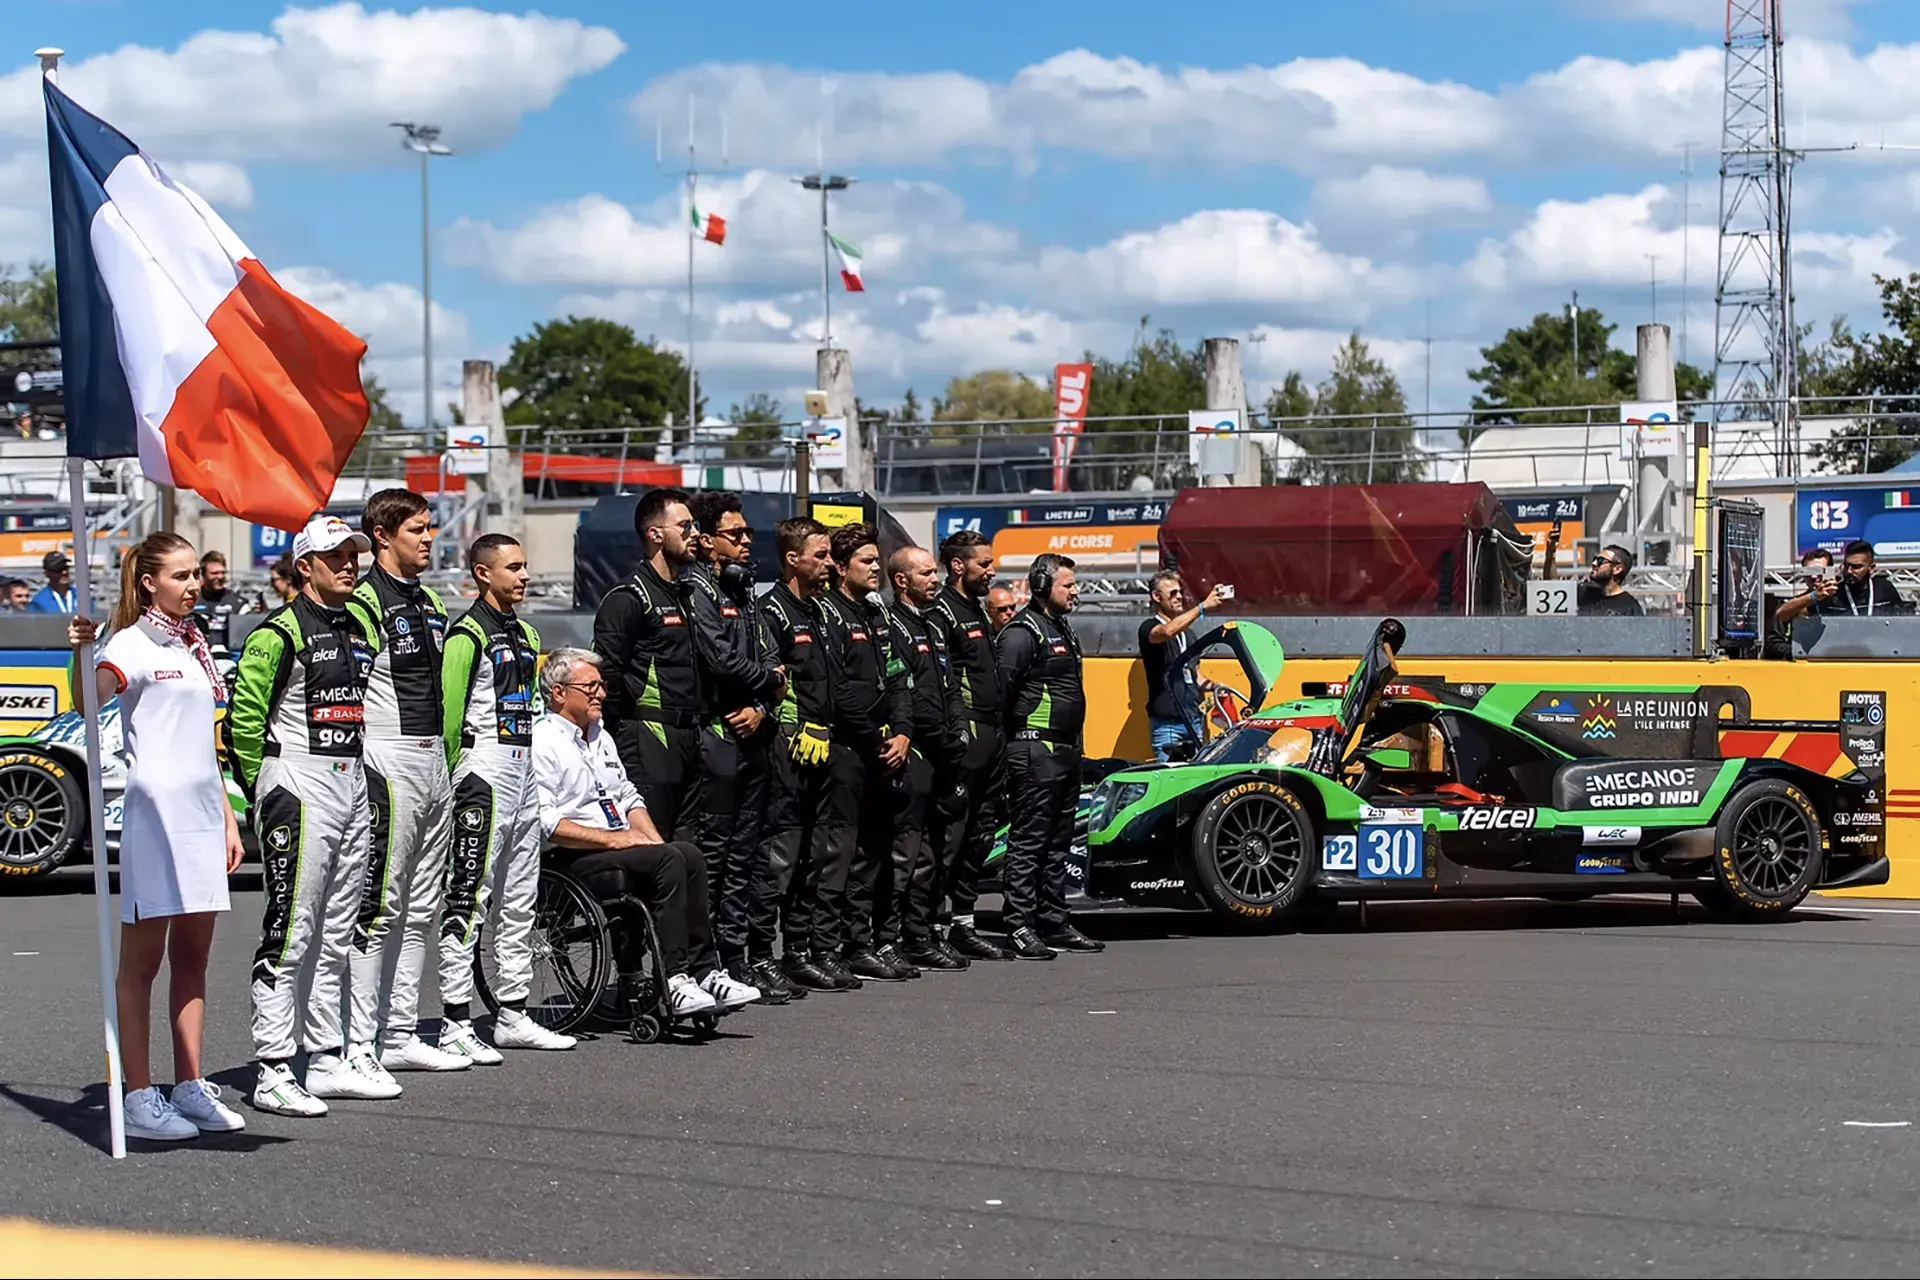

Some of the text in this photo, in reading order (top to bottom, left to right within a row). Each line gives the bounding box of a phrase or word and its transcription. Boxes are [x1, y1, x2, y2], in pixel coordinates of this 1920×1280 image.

[1810, 501, 1850, 531] 83
[1048, 535, 1114, 549] AF CORSE
[1536, 590, 1569, 614] 32
[1847, 694, 1881, 704] MOTUL
[1616, 699, 1708, 717] LA RÉUNION
[1589, 790, 1699, 807] GRUPO INDI
[1459, 806, 1535, 830] telcel
[1597, 829, 1627, 838] WEC
[1840, 834, 1878, 844] GOODYEAR
[1326, 841, 1354, 865] P2
[1366, 829, 1416, 876] 30
[1130, 878, 1185, 890] GOODYEAR
